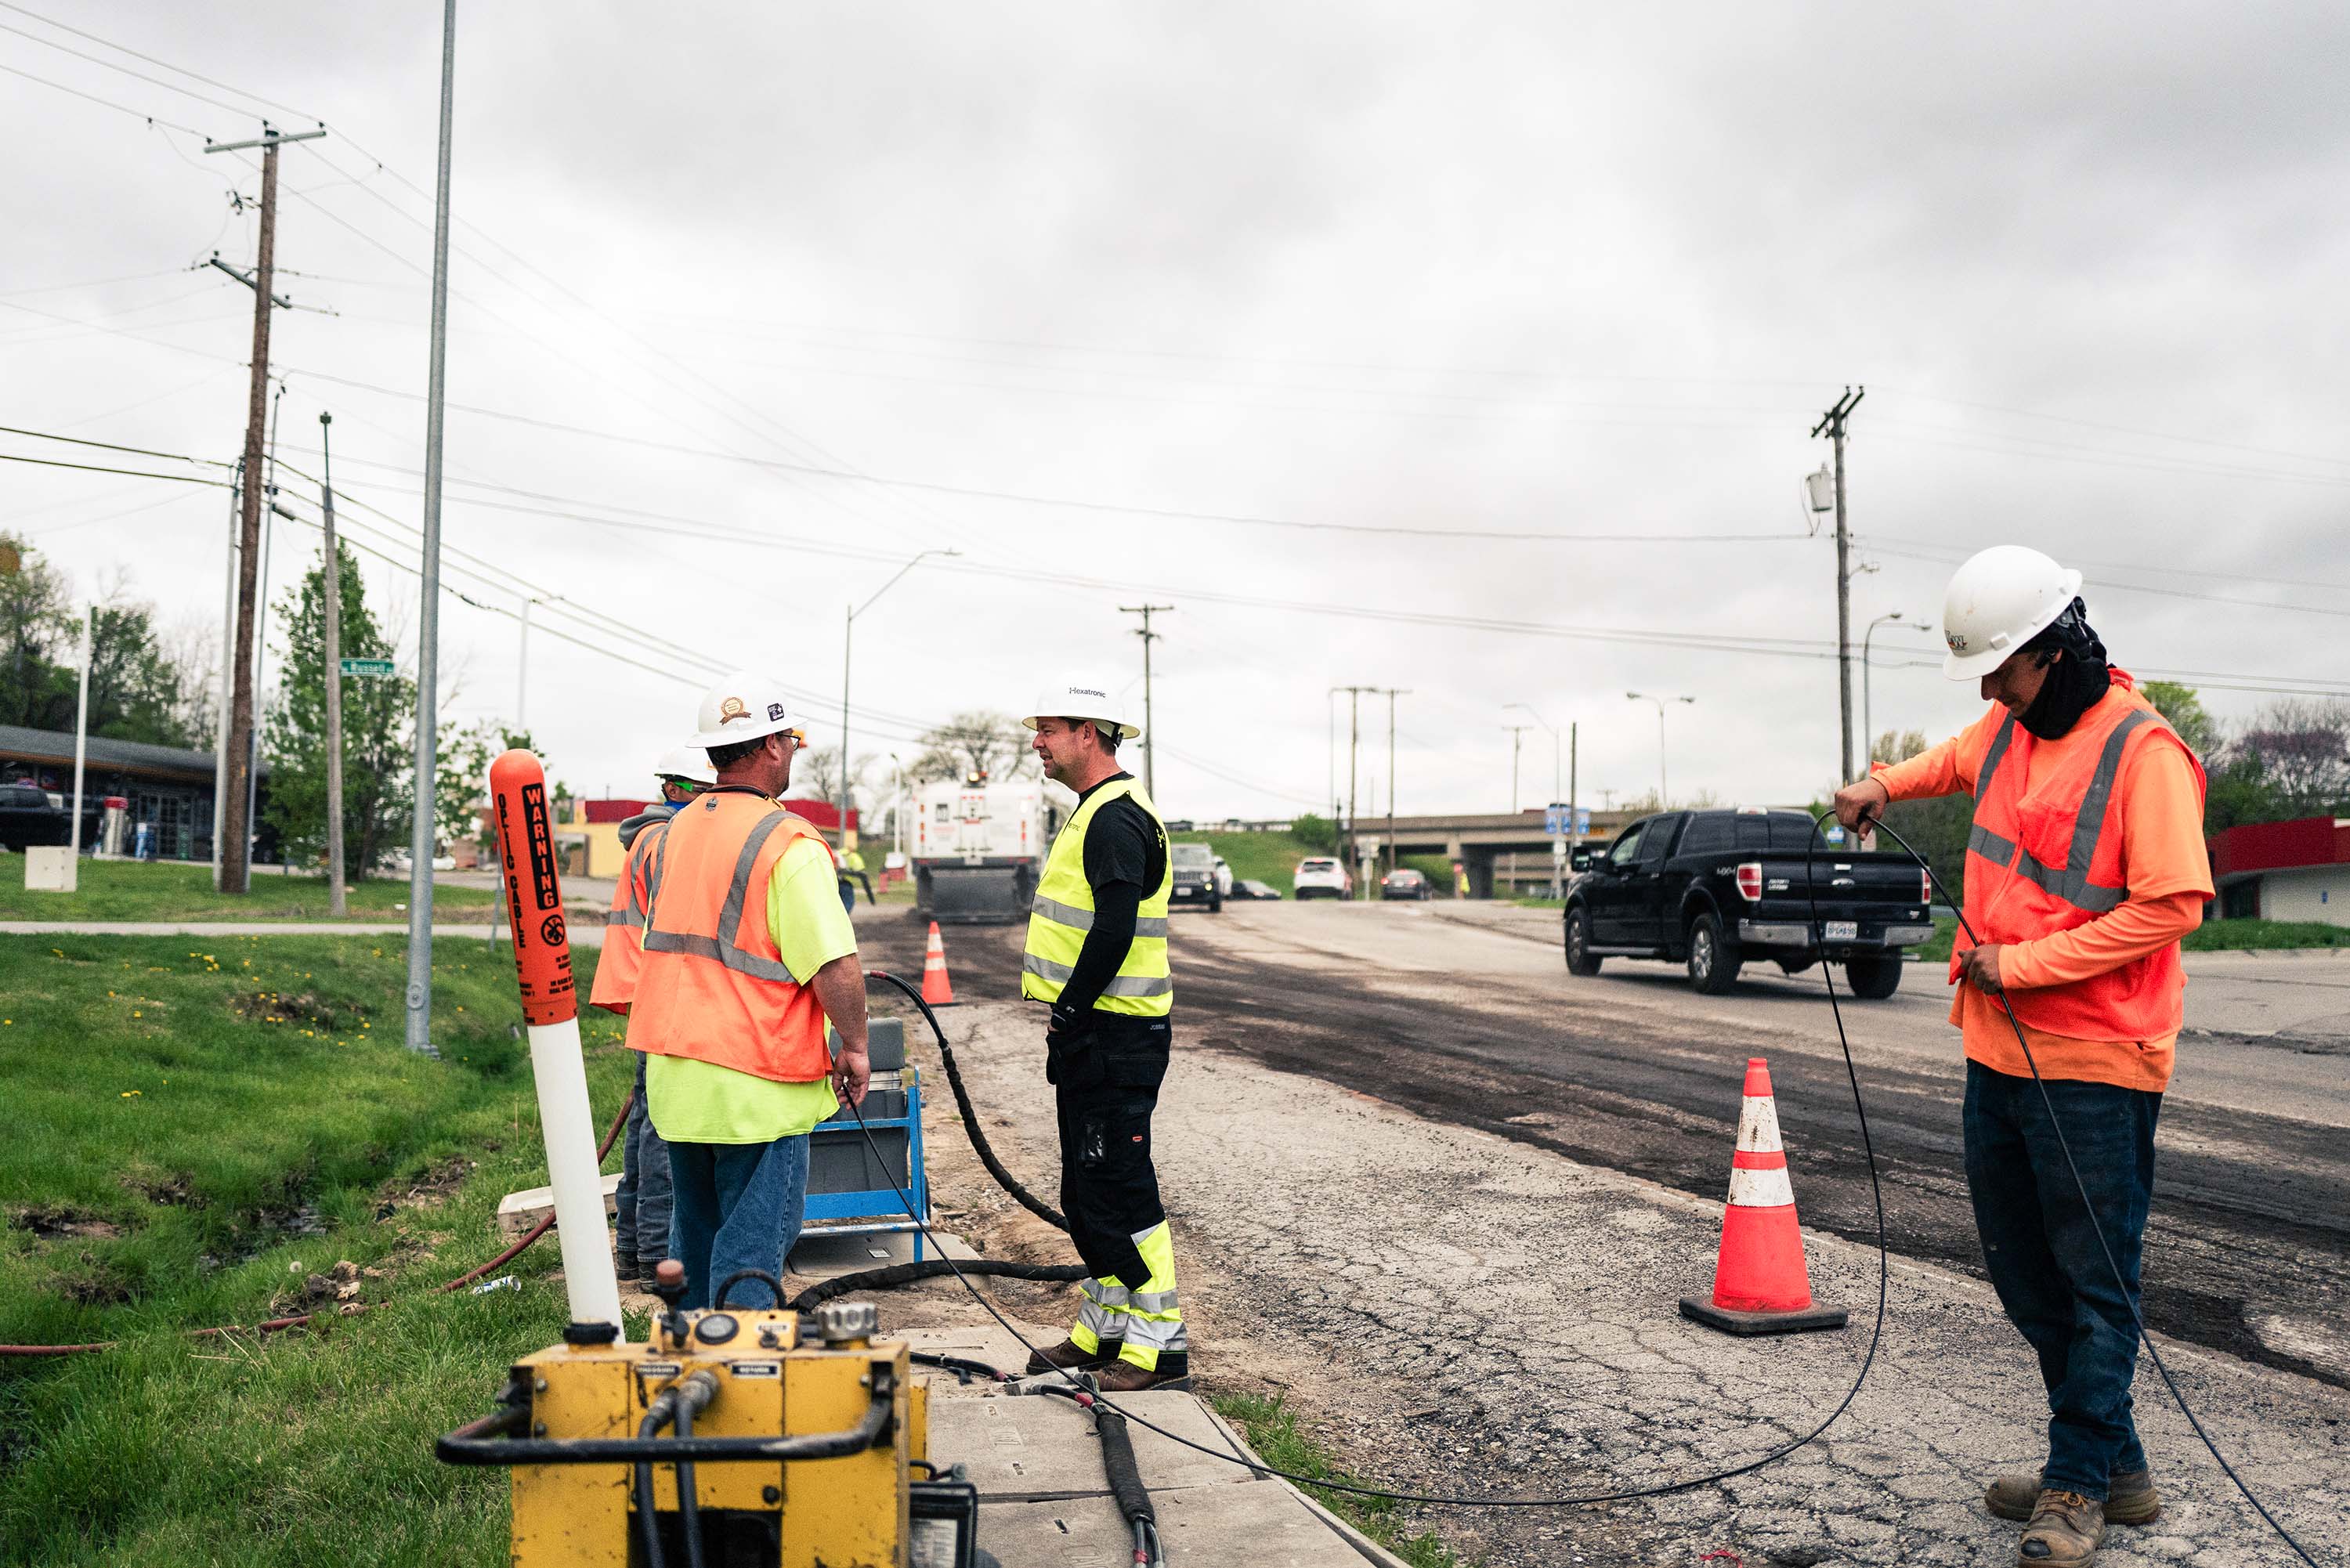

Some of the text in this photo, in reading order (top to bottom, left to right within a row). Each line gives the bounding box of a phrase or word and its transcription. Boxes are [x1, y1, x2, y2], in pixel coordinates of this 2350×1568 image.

[1068, 687, 1106, 698] Hexatronic
[498, 793, 526, 948] OPTIC CABLE
[526, 787, 555, 908] WARNING
